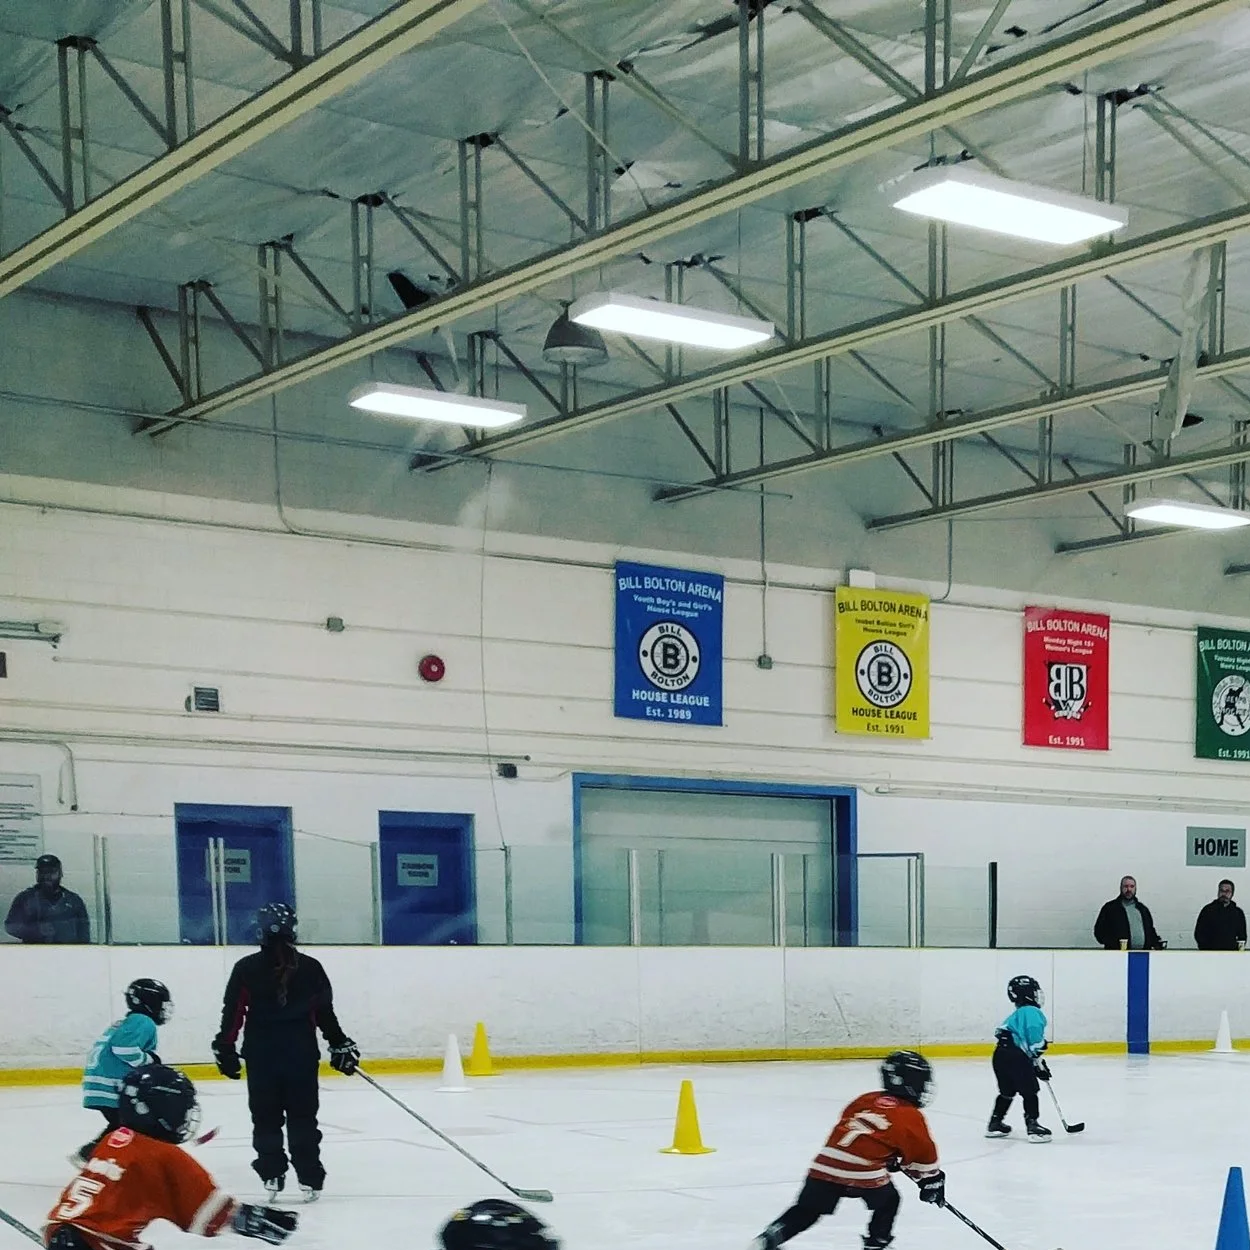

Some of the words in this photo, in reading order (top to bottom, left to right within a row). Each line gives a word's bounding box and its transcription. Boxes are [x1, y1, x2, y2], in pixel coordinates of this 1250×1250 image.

[618, 576, 642, 591] BILL
[644, 576, 686, 593] BOLTON
[687, 582, 722, 603] ARENA
[838, 600, 858, 614] BILL
[860, 600, 896, 613] BOLTON
[898, 603, 928, 622] ARENA
[658, 624, 682, 637] BILL
[1027, 619, 1046, 633] BILL
[1046, 619, 1080, 634] BOLTON
[1081, 623, 1108, 641] ARENA
[873, 645, 894, 655] BILL
[1199, 639, 1216, 652] BILL
[1217, 639, 1247, 651] BOLTON
[662, 641, 680, 669] B
[651, 671, 690, 687] BOLTON
[877, 661, 892, 687] B
[632, 689, 668, 703] HOUSE
[670, 693, 710, 707] LEAGUE
[868, 688, 902, 703] BOLTON
[646, 706, 665, 718] Est.
[667, 708, 692, 720] 1989
[852, 707, 882, 718] HOUSE
[885, 710, 918, 721] LEAGUE
[866, 722, 882, 733] Est.
[885, 724, 905, 734] 1991
[1194, 837, 1239, 857] HOME
[57, 1176, 106, 1220] 5
